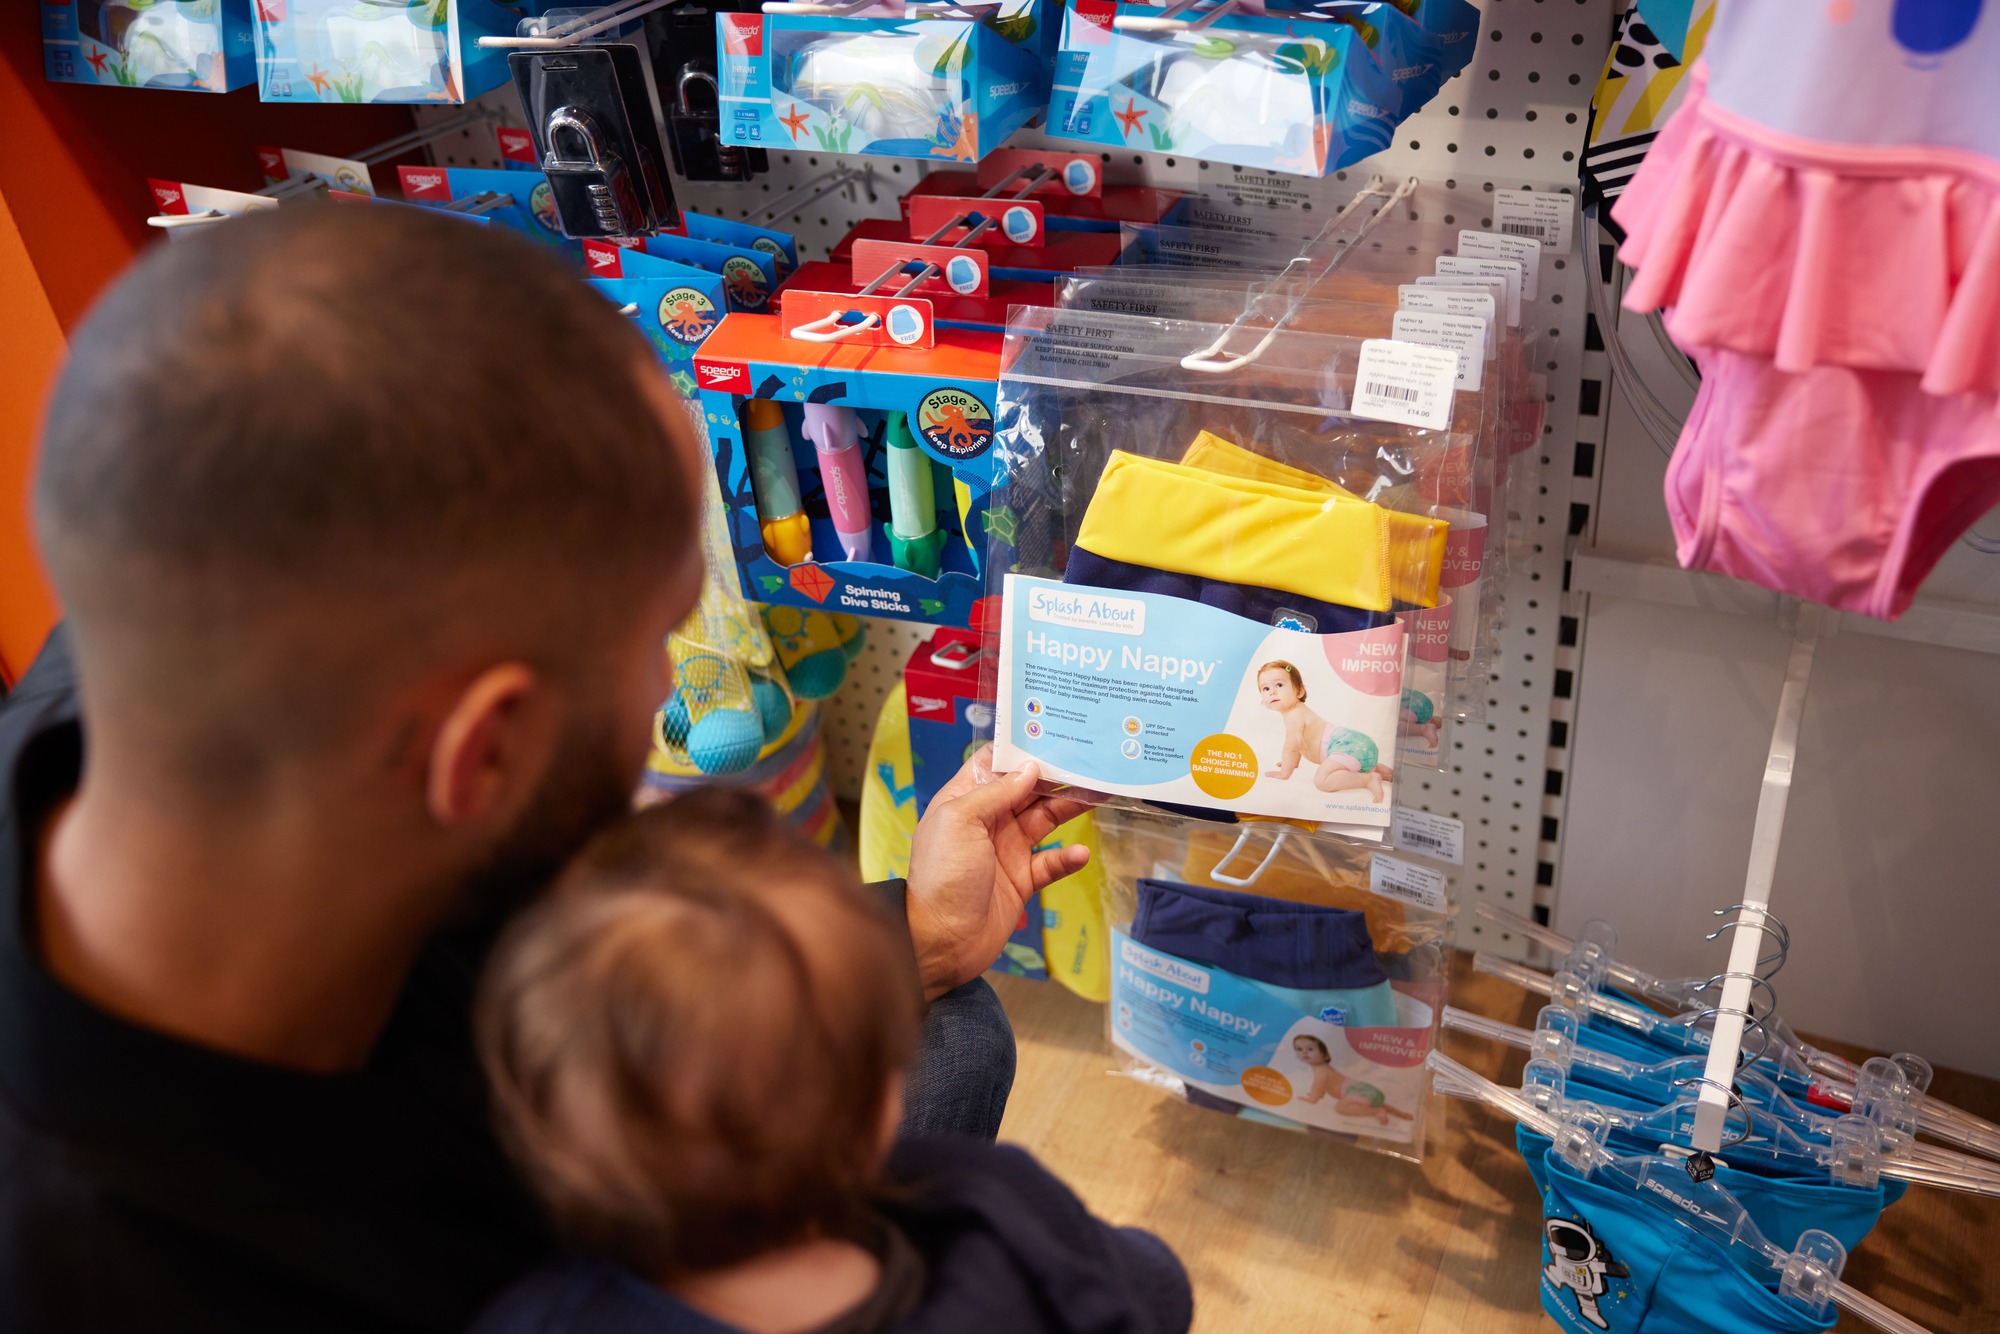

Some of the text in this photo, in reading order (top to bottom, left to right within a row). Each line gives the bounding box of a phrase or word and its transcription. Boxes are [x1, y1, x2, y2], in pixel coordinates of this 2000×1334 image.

[1079, 13, 1111, 24] speedo
[729, 25, 759, 35] speedo
[732, 66, 756, 74] INFANT
[1392, 65, 1422, 81] speedo
[990, 82, 1019, 99] speedo
[1348, 99, 1379, 117] speedo
[406, 174, 441, 184] speedo
[1234, 175, 1291, 188] SAFETY FIRST
[155, 188, 180, 200] speedo
[1194, 210, 1226, 221] SAFETY
[1228, 214, 1252, 225] FIRST
[1015, 232, 1030, 241] FREE
[1159, 240, 1193, 250] SAFETY
[1196, 244, 1221, 254] FIRST
[588, 248, 615, 263] speedo
[1168, 252, 1241, 267] DANGER SUFFOCATION
[727, 260, 760, 277] Stage 3
[959, 283, 974, 292] FREE
[665, 287, 706, 306] Stage 3
[1091, 300, 1127, 310] SAFETY
[1129, 304, 1158, 313] FIRST
[667, 323, 713, 342] Keep Exploring
[900, 333, 917, 343] FREE
[1046, 323, 1083, 335] SAFETY
[1086, 327, 1114, 338] FIRST
[1032, 337, 1052, 345] AVOID
[1053, 339, 1079, 347] DANGER
[1091, 342, 1134, 352] SUFFOCATION
[1040, 355, 1062, 363] BABIES
[1078, 359, 1110, 368] CHILDREN
[700, 365, 741, 378] speedo
[928, 392, 980, 413] Stage 3
[1408, 408, 1430, 417] £14.00
[927, 430, 987, 455] Keep Exploring
[827, 466, 848, 506] speedo
[845, 584, 901, 602] Spinning
[841, 595, 910, 613] Dive Sticks
[1032, 593, 1135, 622] Splash About
[1053, 614, 1071, 622] Trusted
[1416, 620, 1450, 630] NEW
[1027, 630, 1113, 672] Happy
[1359, 643, 1398, 656] NEW
[1049, 667, 1072, 677] improved
[1073, 672, 1090, 681] Happy
[1092, 675, 1110, 684] Nappy
[1139, 682, 1165, 691] specially
[1166, 686, 1193, 695] designed
[1025, 678, 1049, 688] Approved
[1051, 681, 1058, 689] by
[1073, 686, 1097, 695] teachers
[1098, 690, 1109, 698] and
[1110, 692, 1131, 702] leading
[1149, 698, 1173, 707] schools.
[1025, 684, 1049, 693] Essential
[1058, 690, 1070, 698] baby
[1071, 693, 1101, 704] swimming!
[1059, 676, 1071, 685] baby
[1081, 681, 1108, 689] maximum
[1109, 685, 1138, 694] protection
[1140, 689, 1162, 698] against
[1162, 692, 1181, 700] faecal
[1182, 695, 1200, 703] leaks.
[910, 695, 947, 709] speedo
[1046, 705, 1088, 718] Maximum Protection
[1046, 711, 1060, 719] against
[1045, 730, 1058, 738] Long
[1059, 732, 1070, 741] lasting
[1075, 736, 1093, 745] reusable
[1145, 729, 1169, 737] protected
[1145, 743, 1157, 751] Body
[1207, 749, 1242, 760] THE NO.1
[1148, 756, 1168, 764] security
[1164, 752, 1184, 760] comfort
[1200, 757, 1248, 769] CHOICE FOR
[1192, 764, 1255, 778] BABY SWIMMING
[1126, 945, 1162, 968] Splash
[1166, 963, 1202, 984] About
[1119, 965, 1184, 1008] Happy
[1190, 997, 1262, 1037] Nappy
[1372, 1033, 1415, 1046] NEW &
[1359, 1042, 1425, 1058] IMPROVED
[1680, 1123, 1739, 1141] spdo
[1646, 1179, 1701, 1214] speedo
[1542, 1276, 1576, 1321] speedo
